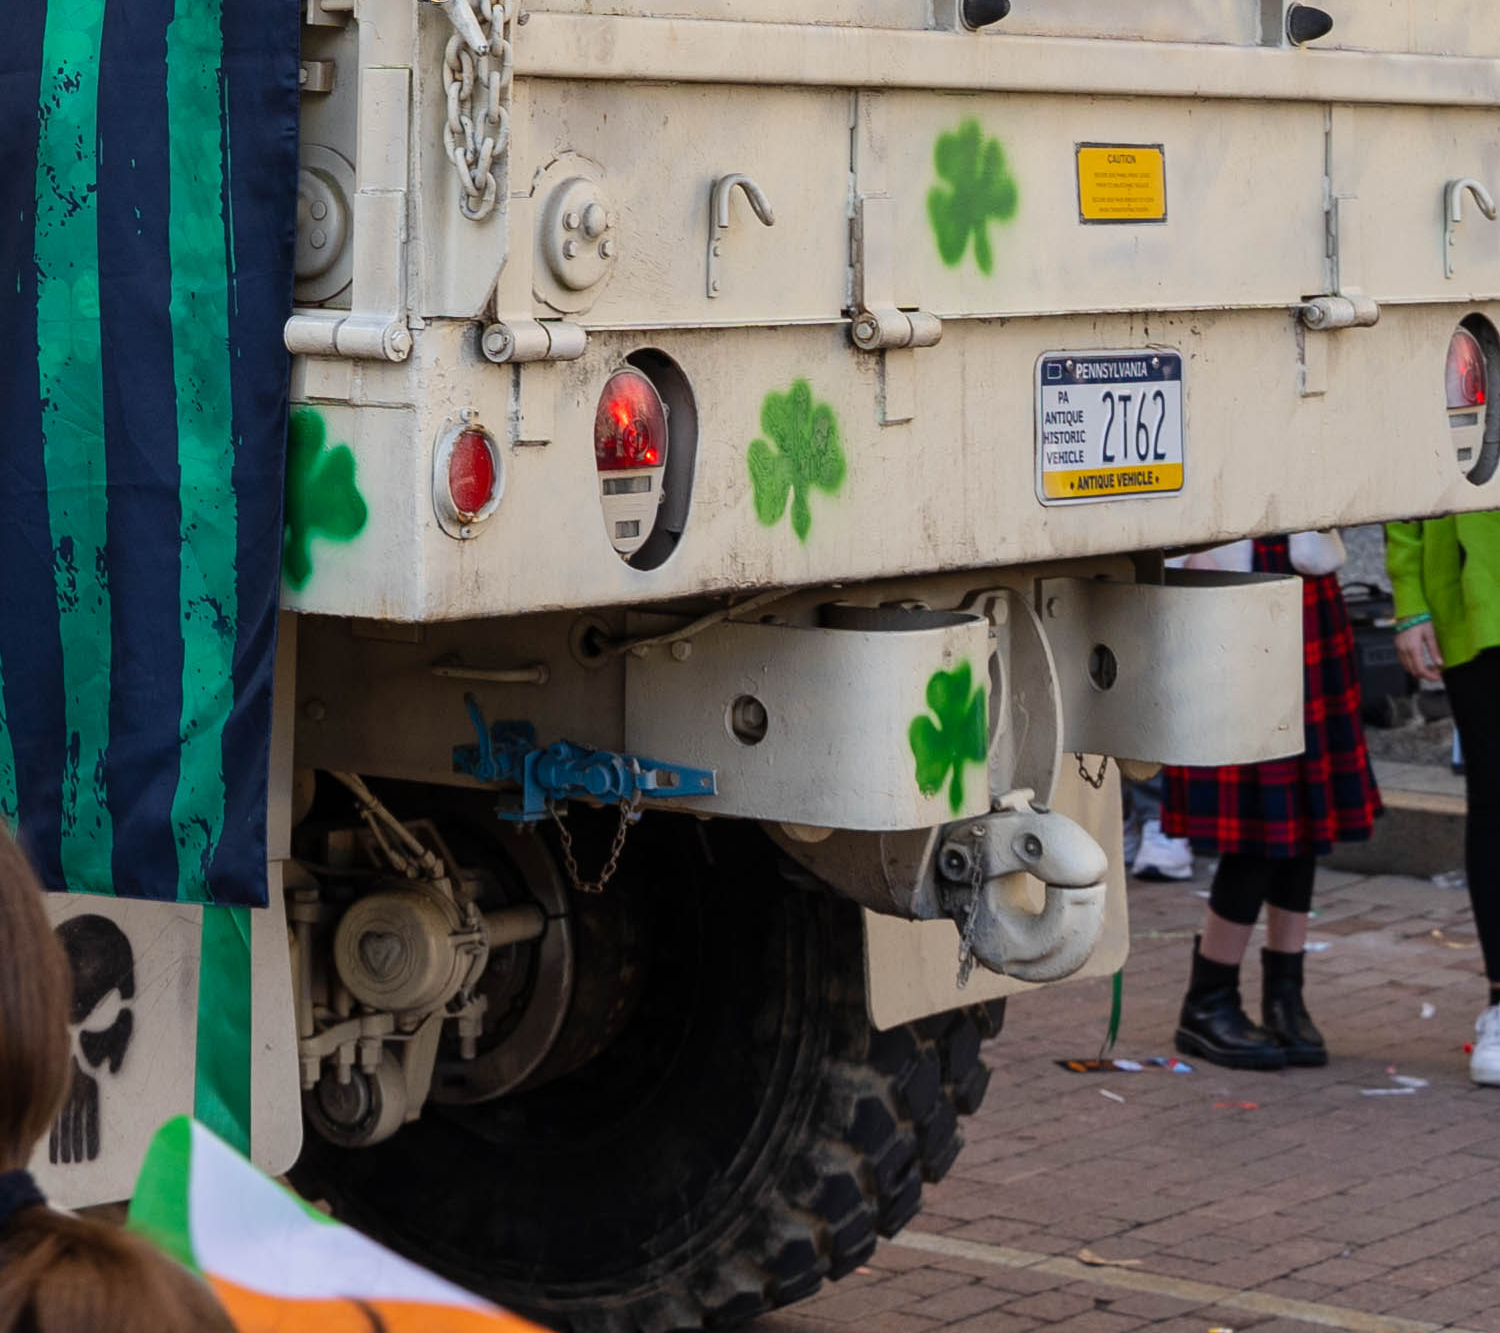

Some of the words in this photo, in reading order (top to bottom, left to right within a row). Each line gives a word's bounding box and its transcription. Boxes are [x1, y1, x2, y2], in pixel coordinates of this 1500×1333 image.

[1076, 361, 1148, 380] PENNSYLVANIA
[1058, 391, 1069, 404] PA
[1044, 410, 1084, 426] ANTIQUE
[1102, 389, 1167, 463] 2T62
[1043, 430, 1086, 445] HISTORIC
[1047, 450, 1085, 465] VEHICLE
[1077, 474, 1116, 491] ANTIQUE
[1117, 470, 1153, 487] VEHICLE
